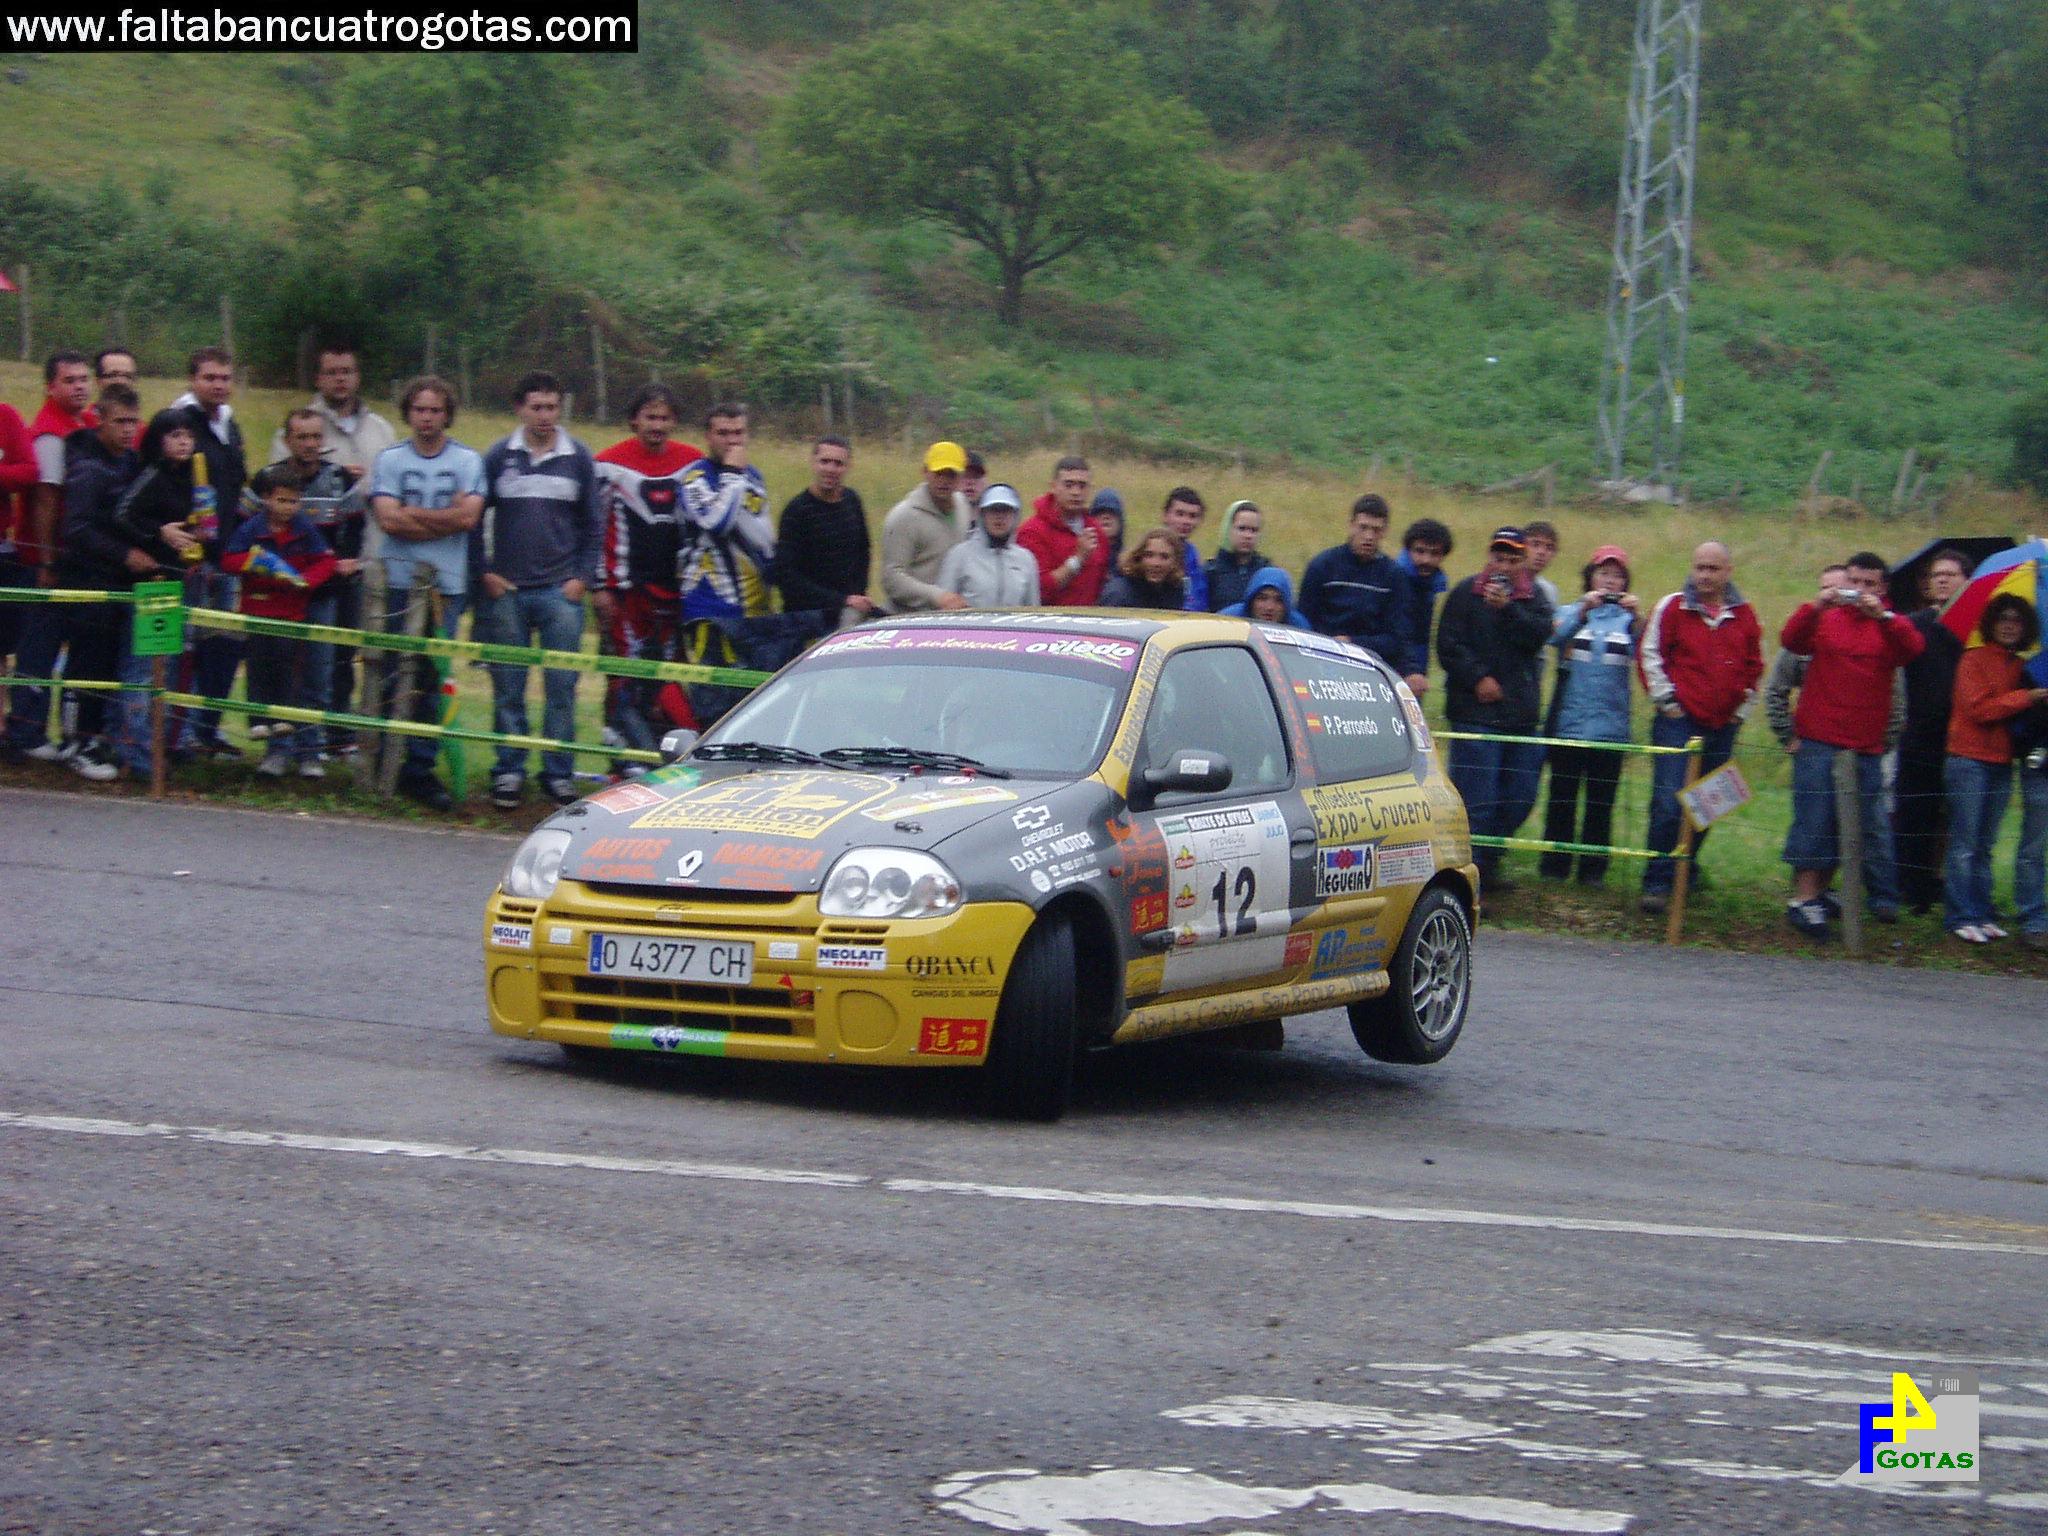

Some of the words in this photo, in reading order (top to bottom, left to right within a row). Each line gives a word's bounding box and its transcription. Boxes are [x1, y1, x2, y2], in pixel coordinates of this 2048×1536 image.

[1025, 639, 1135, 657] oviedo
[1322, 714, 1379, 735] P.Parrondo
[1312, 785, 1363, 811] Muebles
[1048, 831, 1095, 858] MOTOR
[1212, 866, 1258, 939] 12
[492, 926, 531, 940] NEOLAIT
[630, 941, 697, 974] 4377
[709, 946, 747, 978] CH
[818, 948, 885, 961] NEOLAIT
